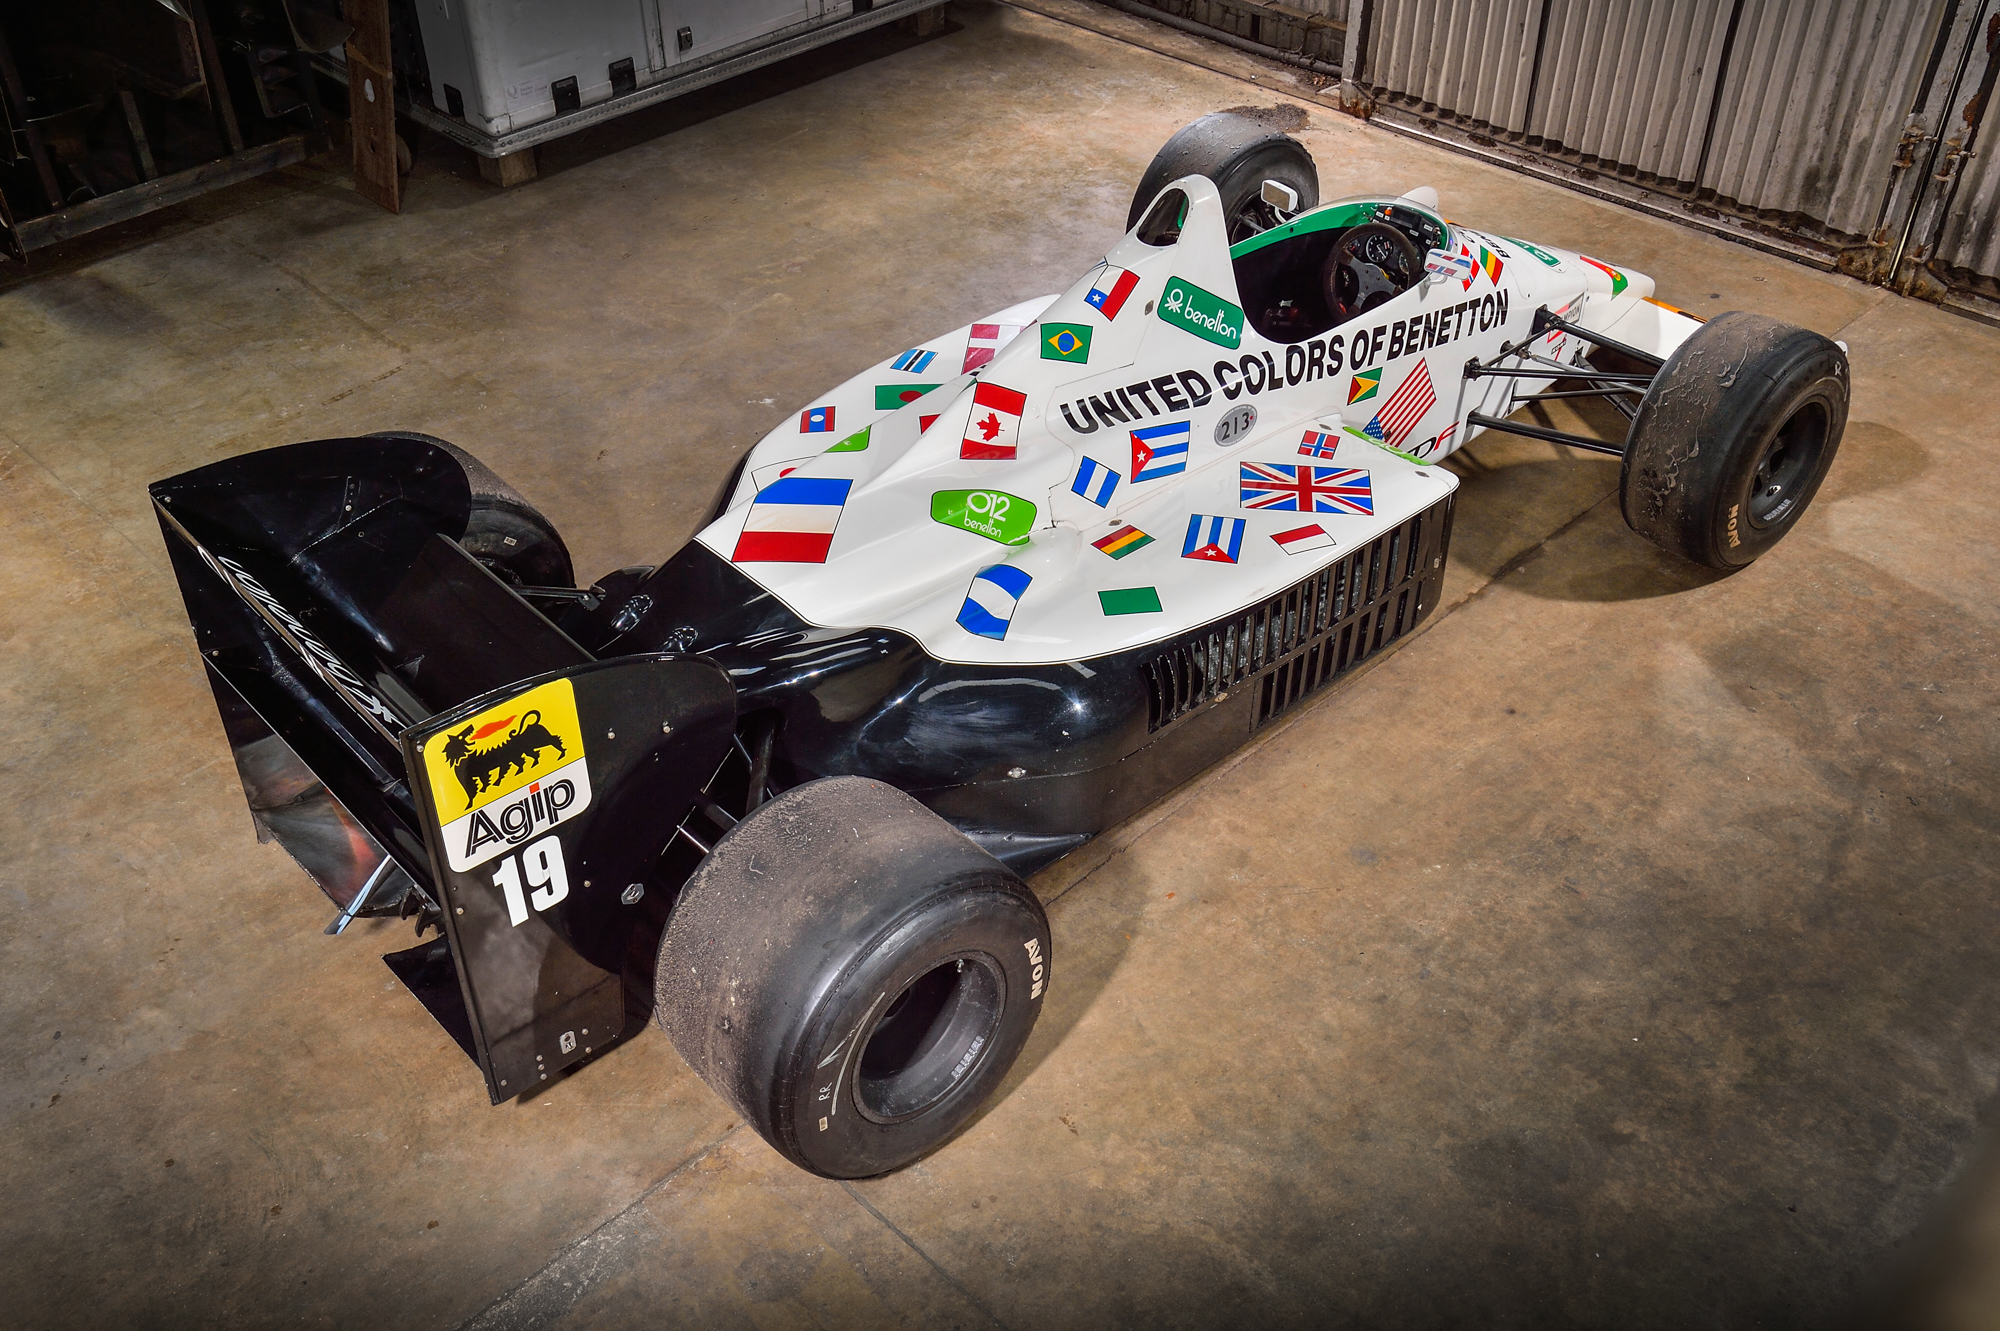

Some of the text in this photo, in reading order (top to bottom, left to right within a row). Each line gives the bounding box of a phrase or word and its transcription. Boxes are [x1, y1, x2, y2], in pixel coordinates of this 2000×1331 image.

[1184, 295, 1237, 340] benetton
[1059, 288, 1509, 434] UNITED COLORS OF BENETTON
[1221, 411, 1250, 441] 213
[963, 510, 1002, 538] benetton
[1727, 503, 1741, 549] AVON
[464, 778, 576, 859] Agip
[492, 835, 570, 928] 19
[1023, 937, 1044, 1000] AVON
